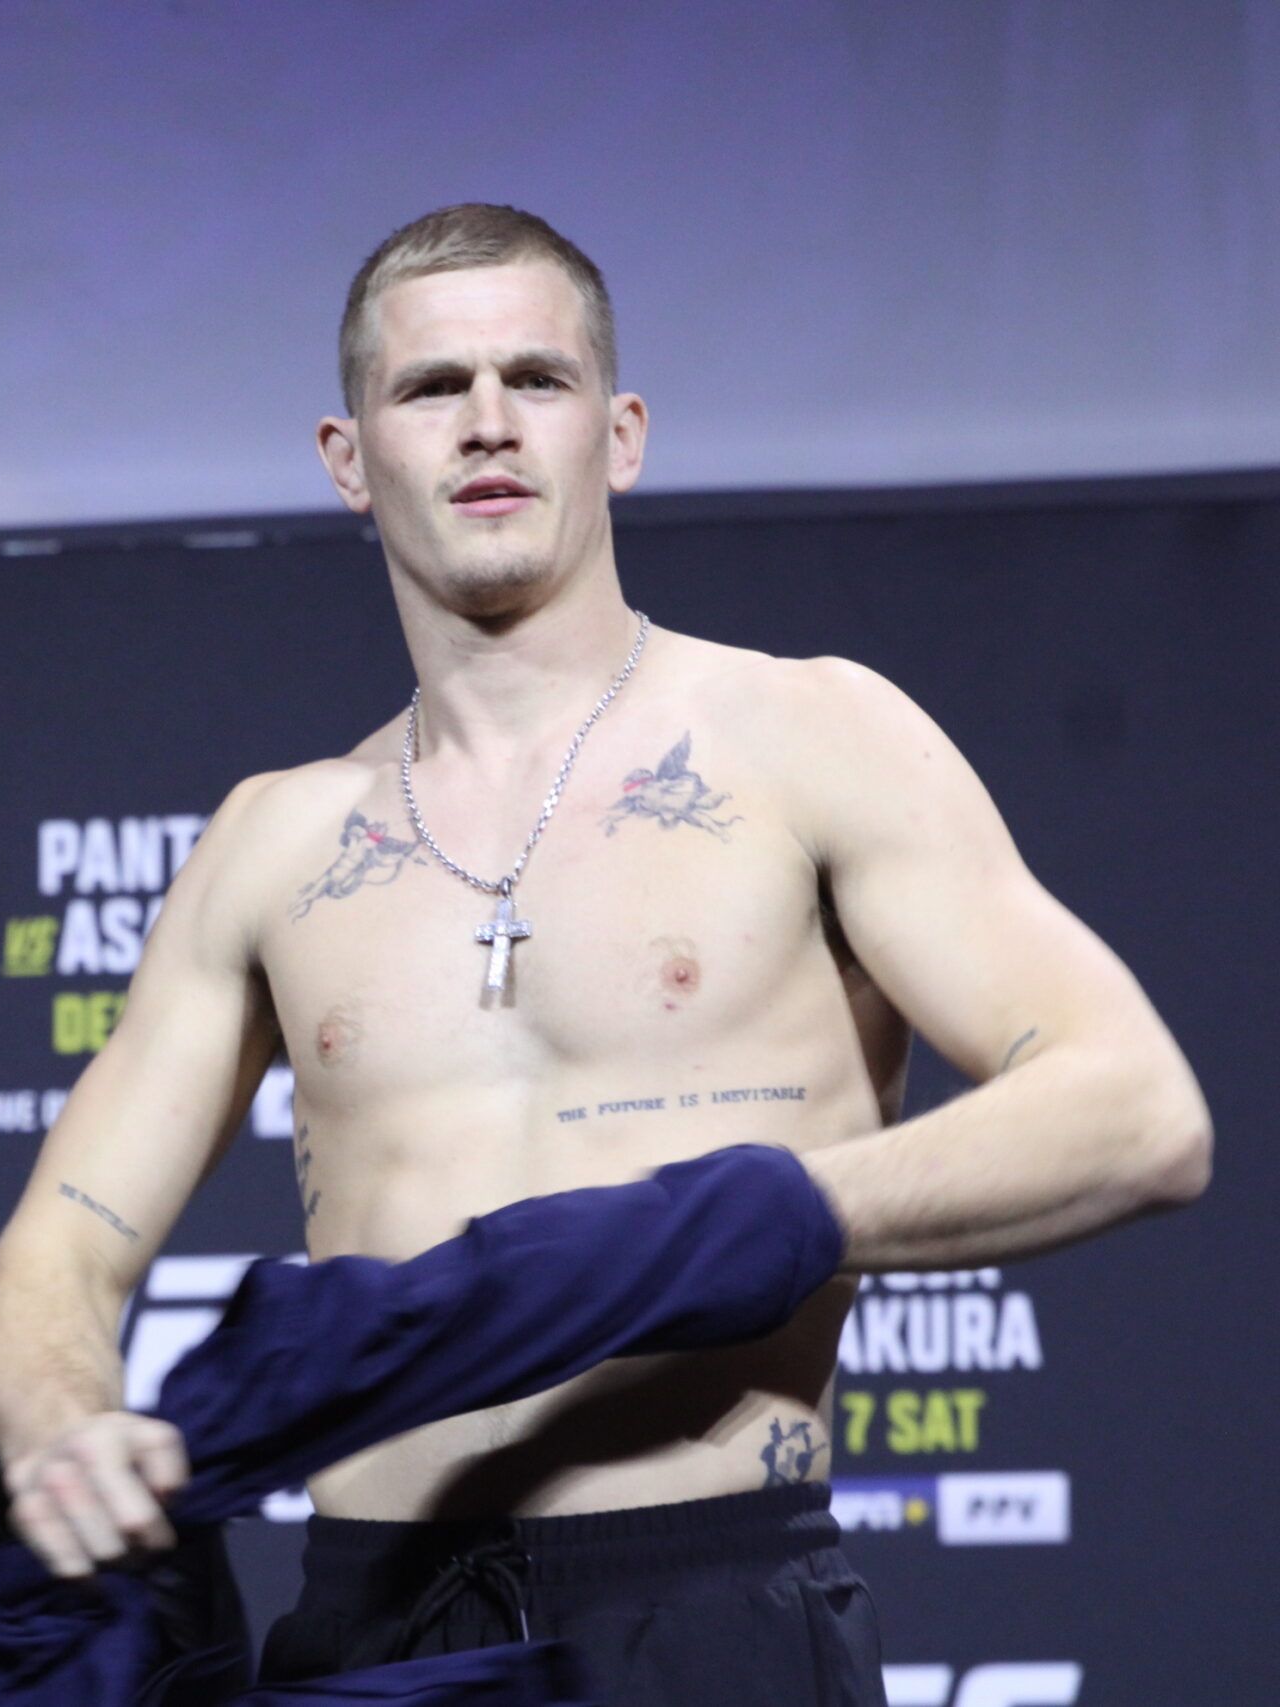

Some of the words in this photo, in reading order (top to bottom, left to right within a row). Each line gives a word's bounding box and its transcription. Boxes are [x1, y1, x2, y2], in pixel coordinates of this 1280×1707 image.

[37, 813, 217, 896] PANT
[52, 991, 129, 1055] DE
[557, 1107, 587, 1123] THE
[598, 1097, 665, 1116] FUTURE
[679, 1093, 699, 1108] IS
[711, 1087, 806, 1104] INEVITABLE
[837, 1291, 1043, 1374] AKURA
[840, 1391, 875, 1454] 7
[886, 1391, 986, 1453] SAT
